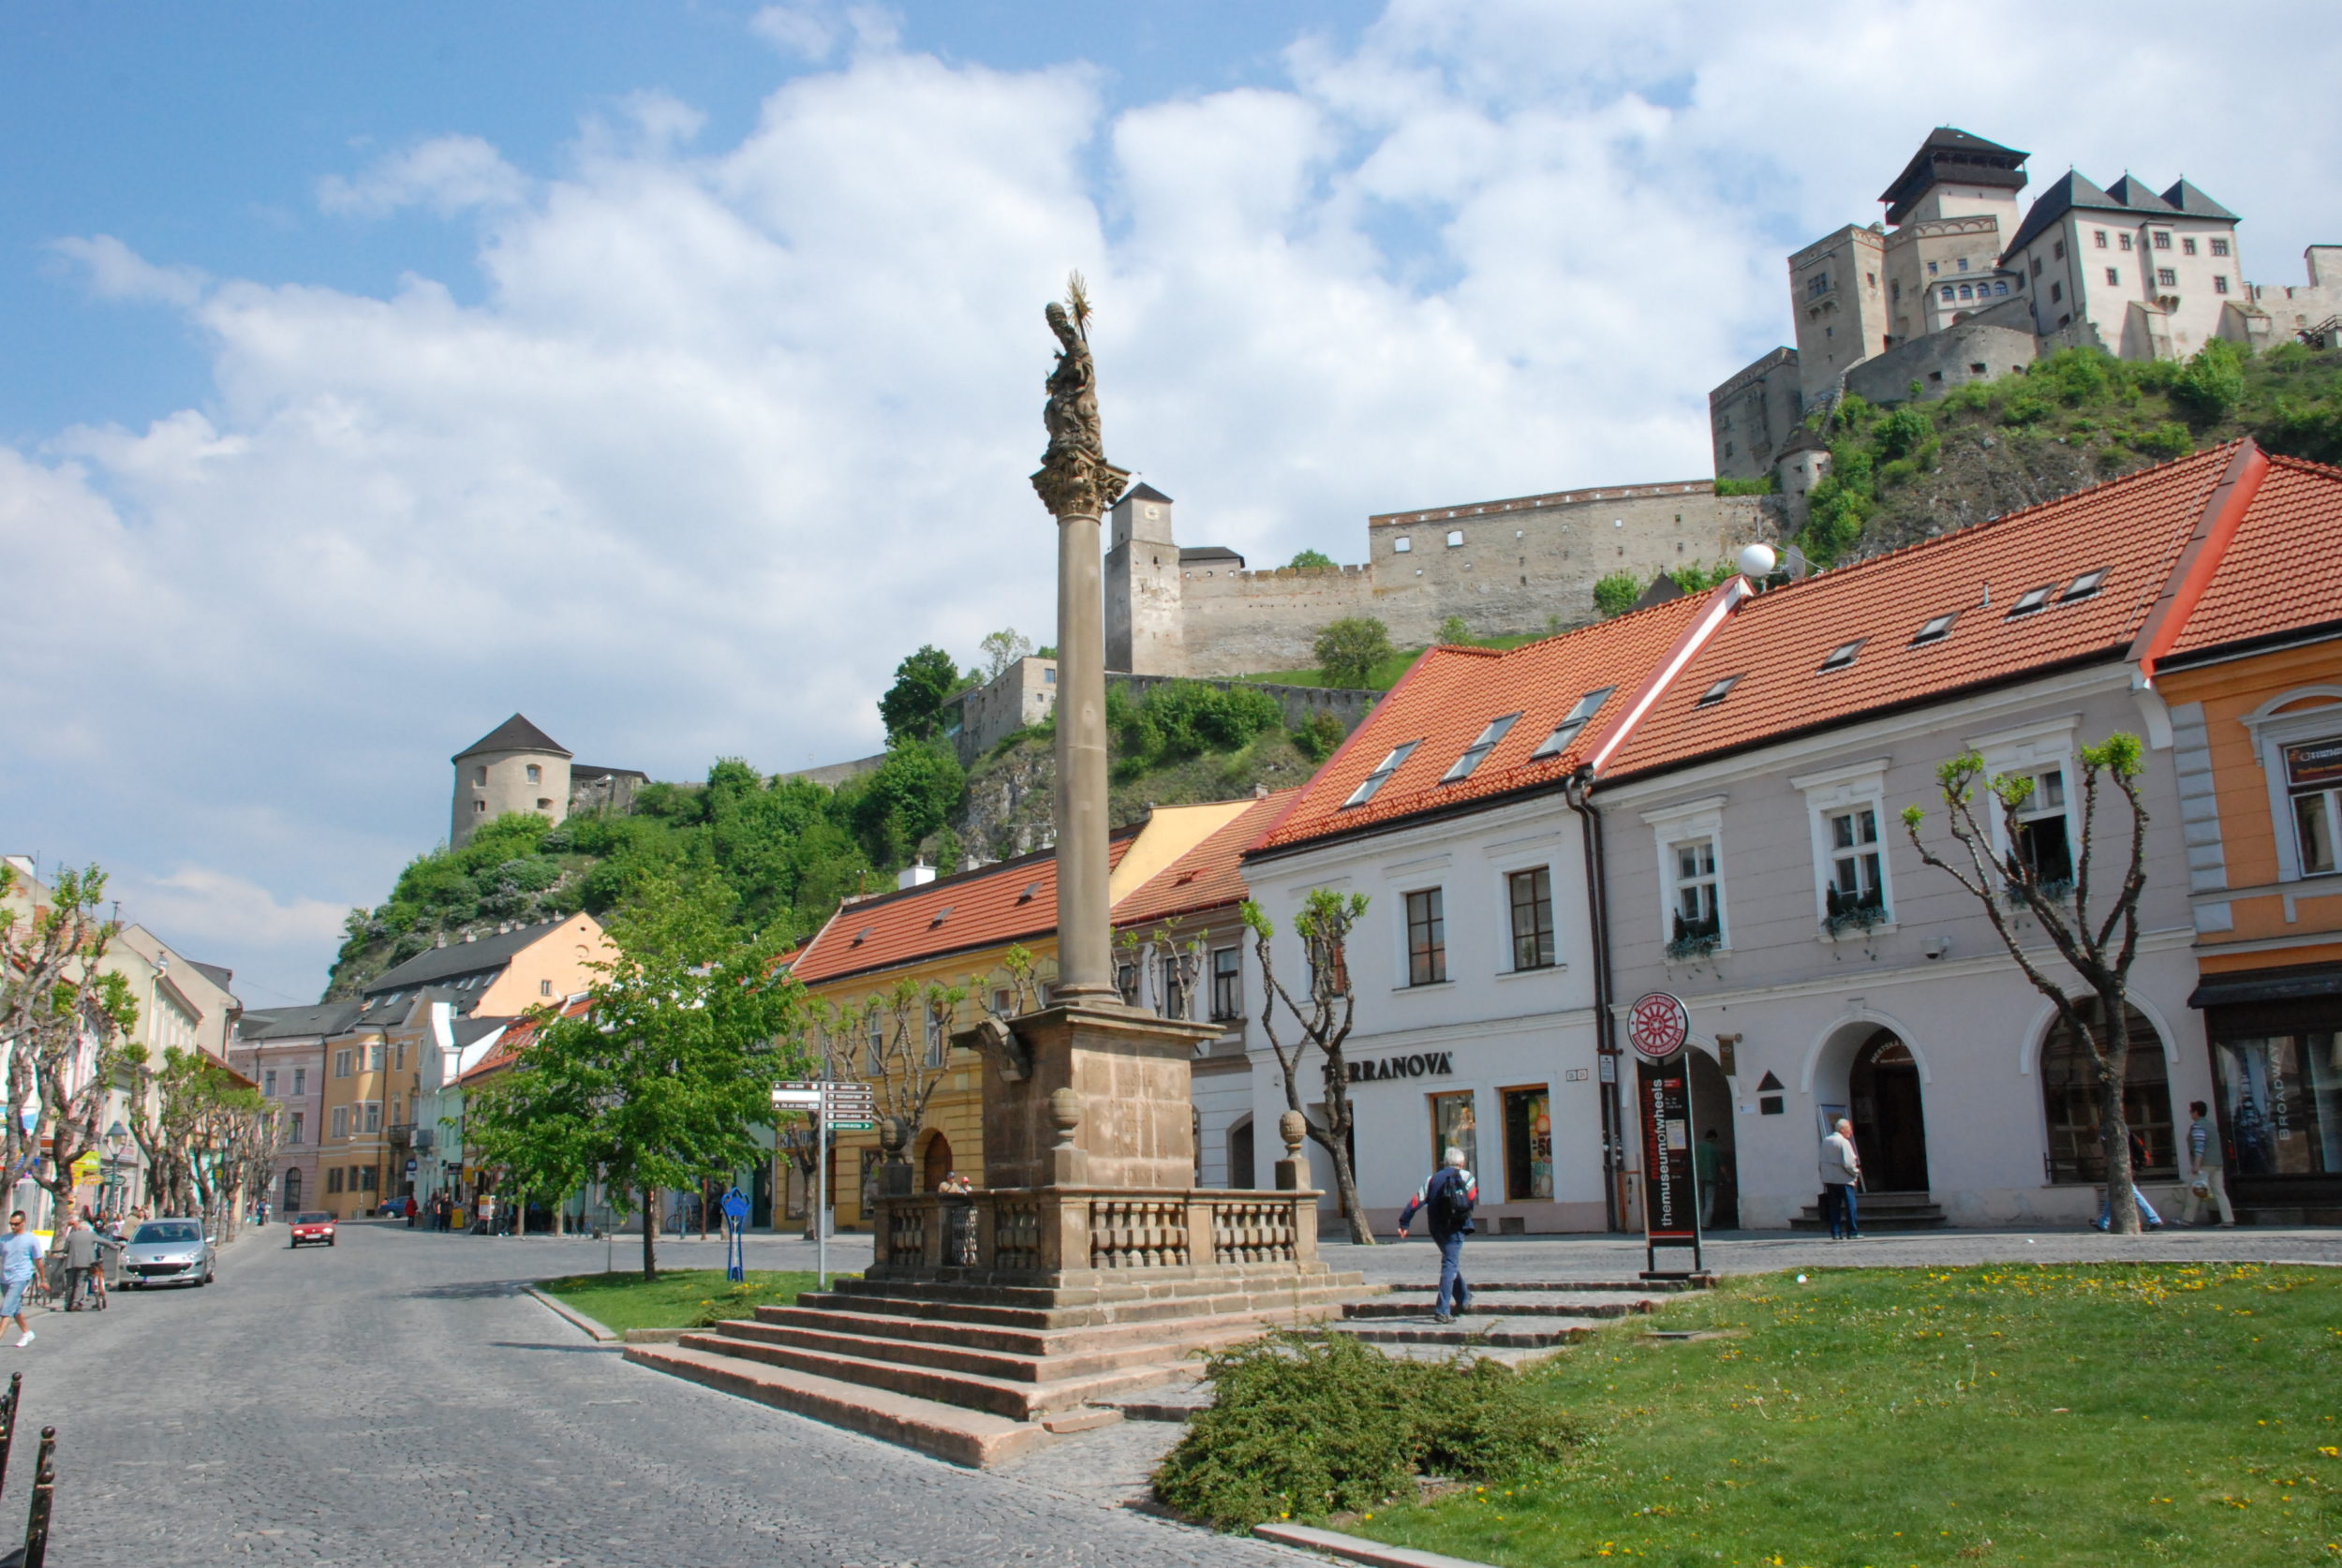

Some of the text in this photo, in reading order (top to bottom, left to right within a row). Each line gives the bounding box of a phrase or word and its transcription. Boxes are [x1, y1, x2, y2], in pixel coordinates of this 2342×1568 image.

[1321, 1051, 1452, 1085] TRRANOVA
[2270, 1044, 2291, 1141] BROADWAY
[1652, 1078, 1673, 1228] themuseumofwheels
